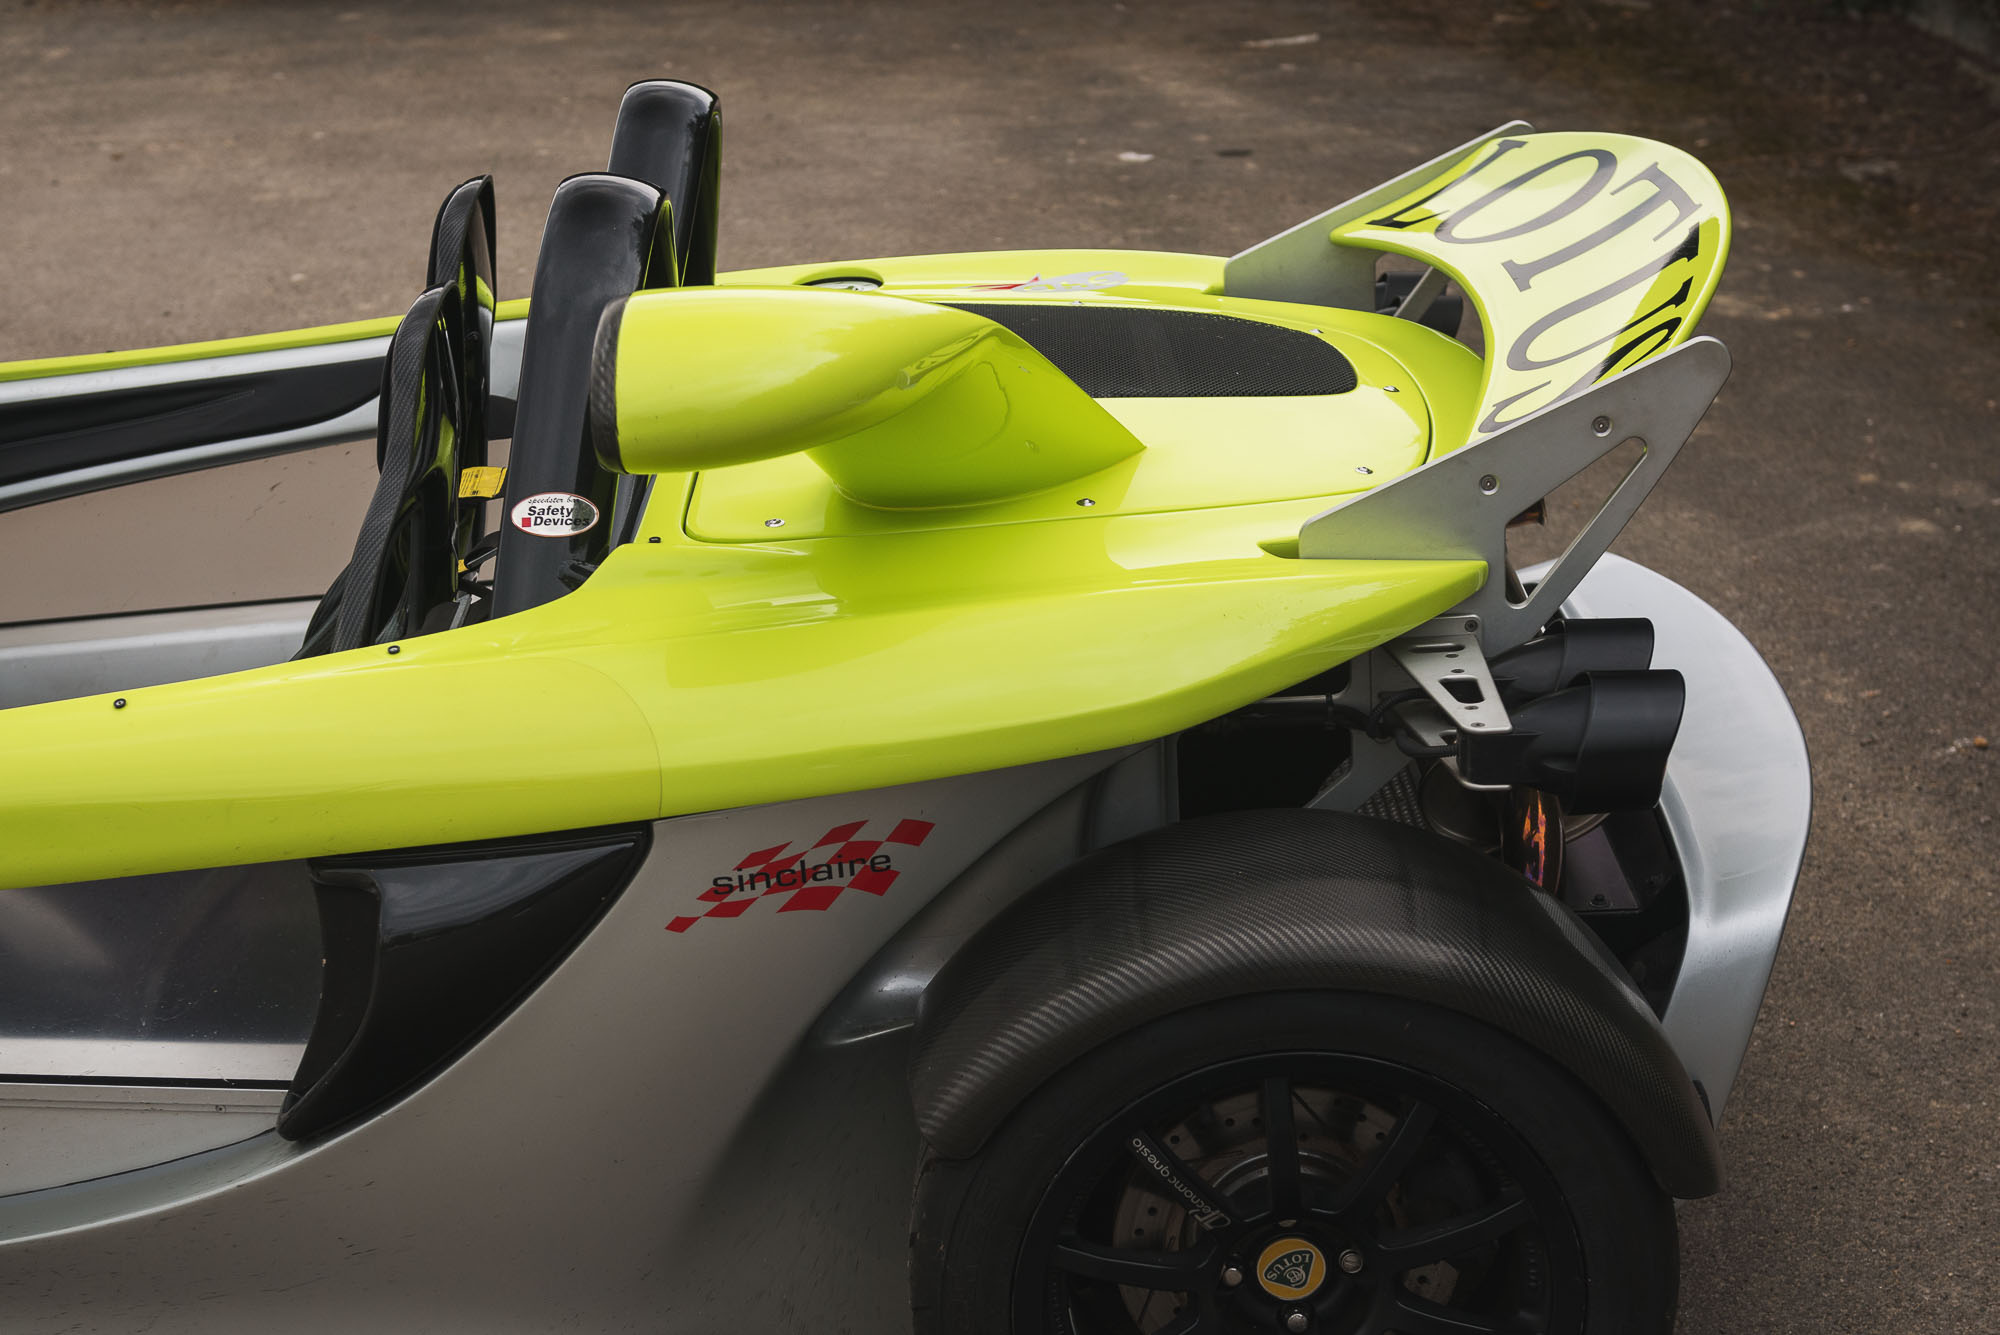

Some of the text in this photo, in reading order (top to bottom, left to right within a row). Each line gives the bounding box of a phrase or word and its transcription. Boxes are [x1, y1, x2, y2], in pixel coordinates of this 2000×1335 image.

[1364, 138, 1703, 434] LOTUS
[527, 505, 575, 518] Safety
[533, 515, 591, 527] Devices
[711, 853, 892, 896] sinclaire
[1266, 1252, 1312, 1282] LOTUS
